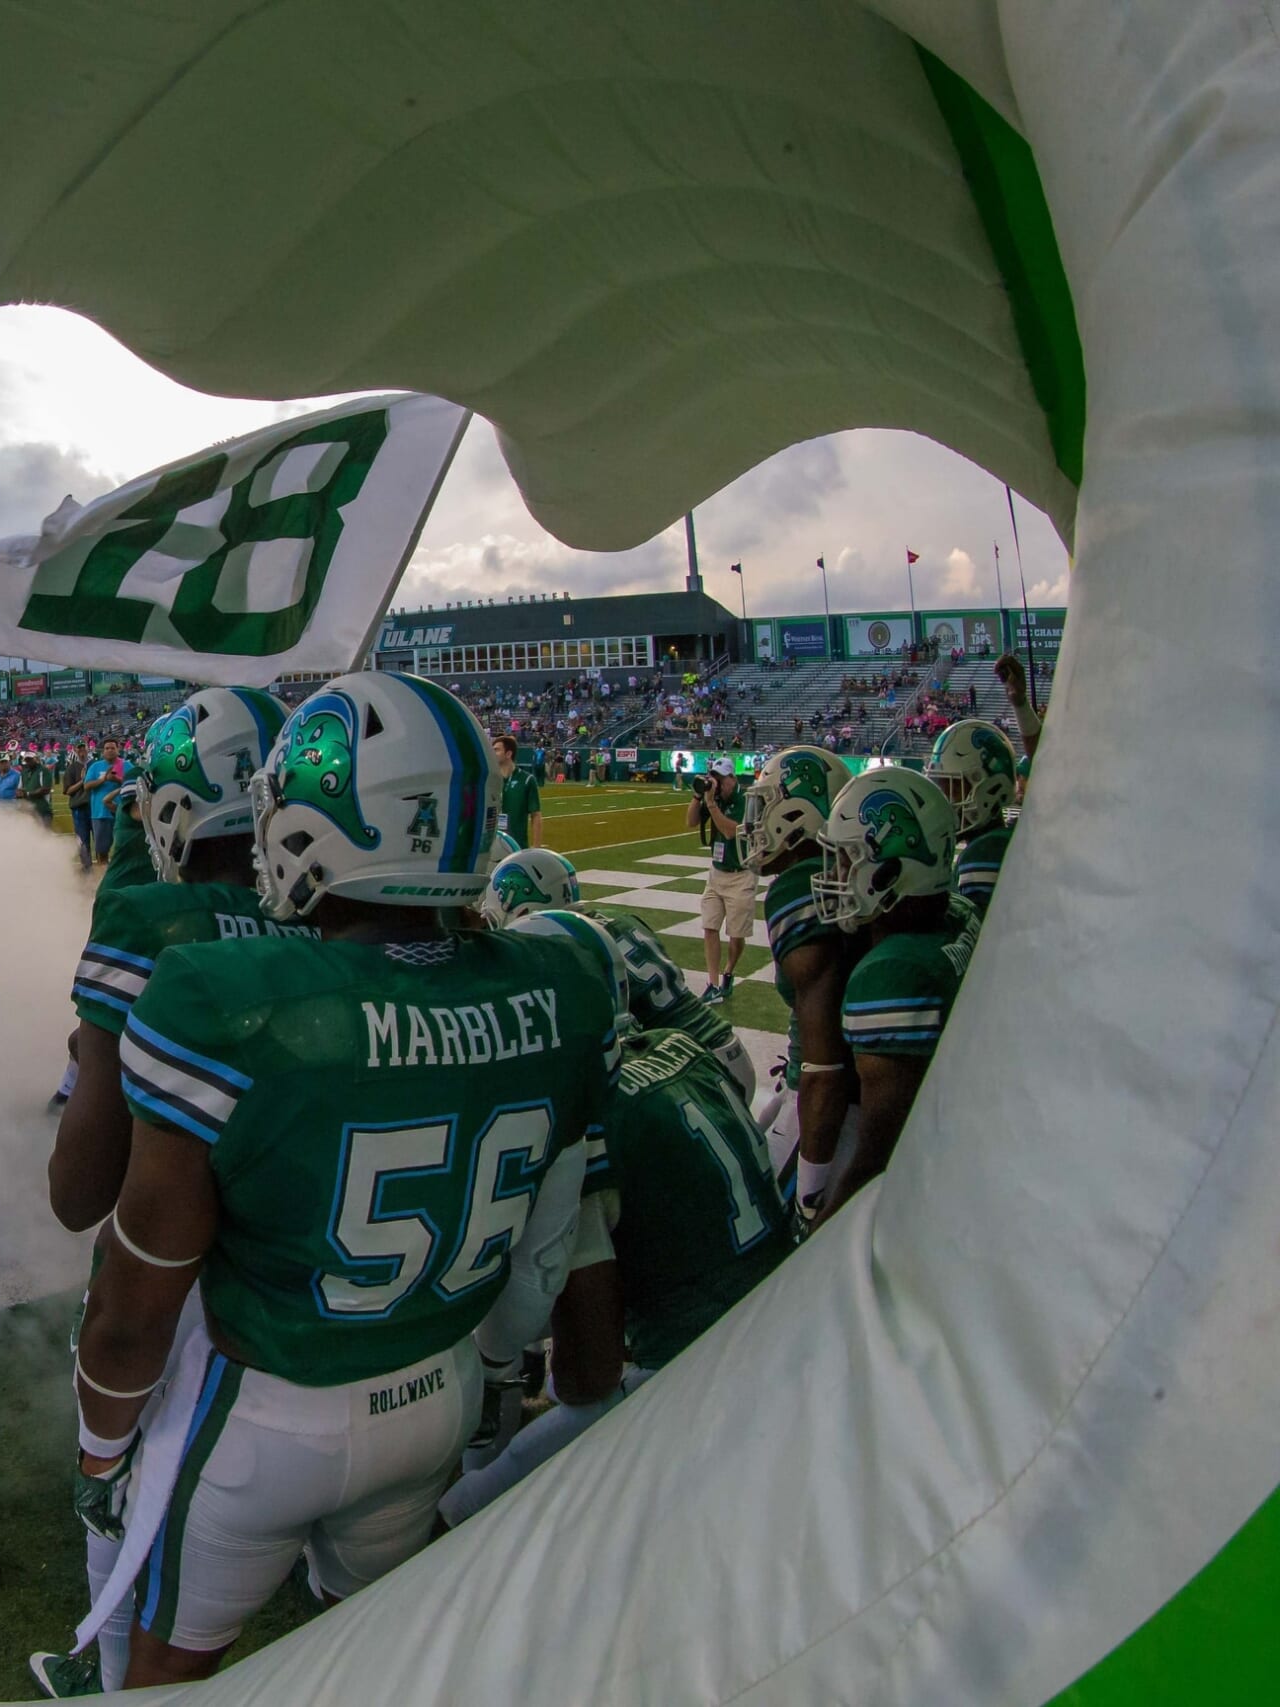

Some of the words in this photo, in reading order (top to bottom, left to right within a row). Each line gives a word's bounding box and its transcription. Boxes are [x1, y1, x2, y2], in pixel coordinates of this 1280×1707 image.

[446, 598, 495, 611] PRESS
[507, 591, 571, 605] CENTER
[410, 839, 432, 854] P6
[361, 988, 561, 1067] MARBLEY
[311, 1098, 554, 1320] 56
